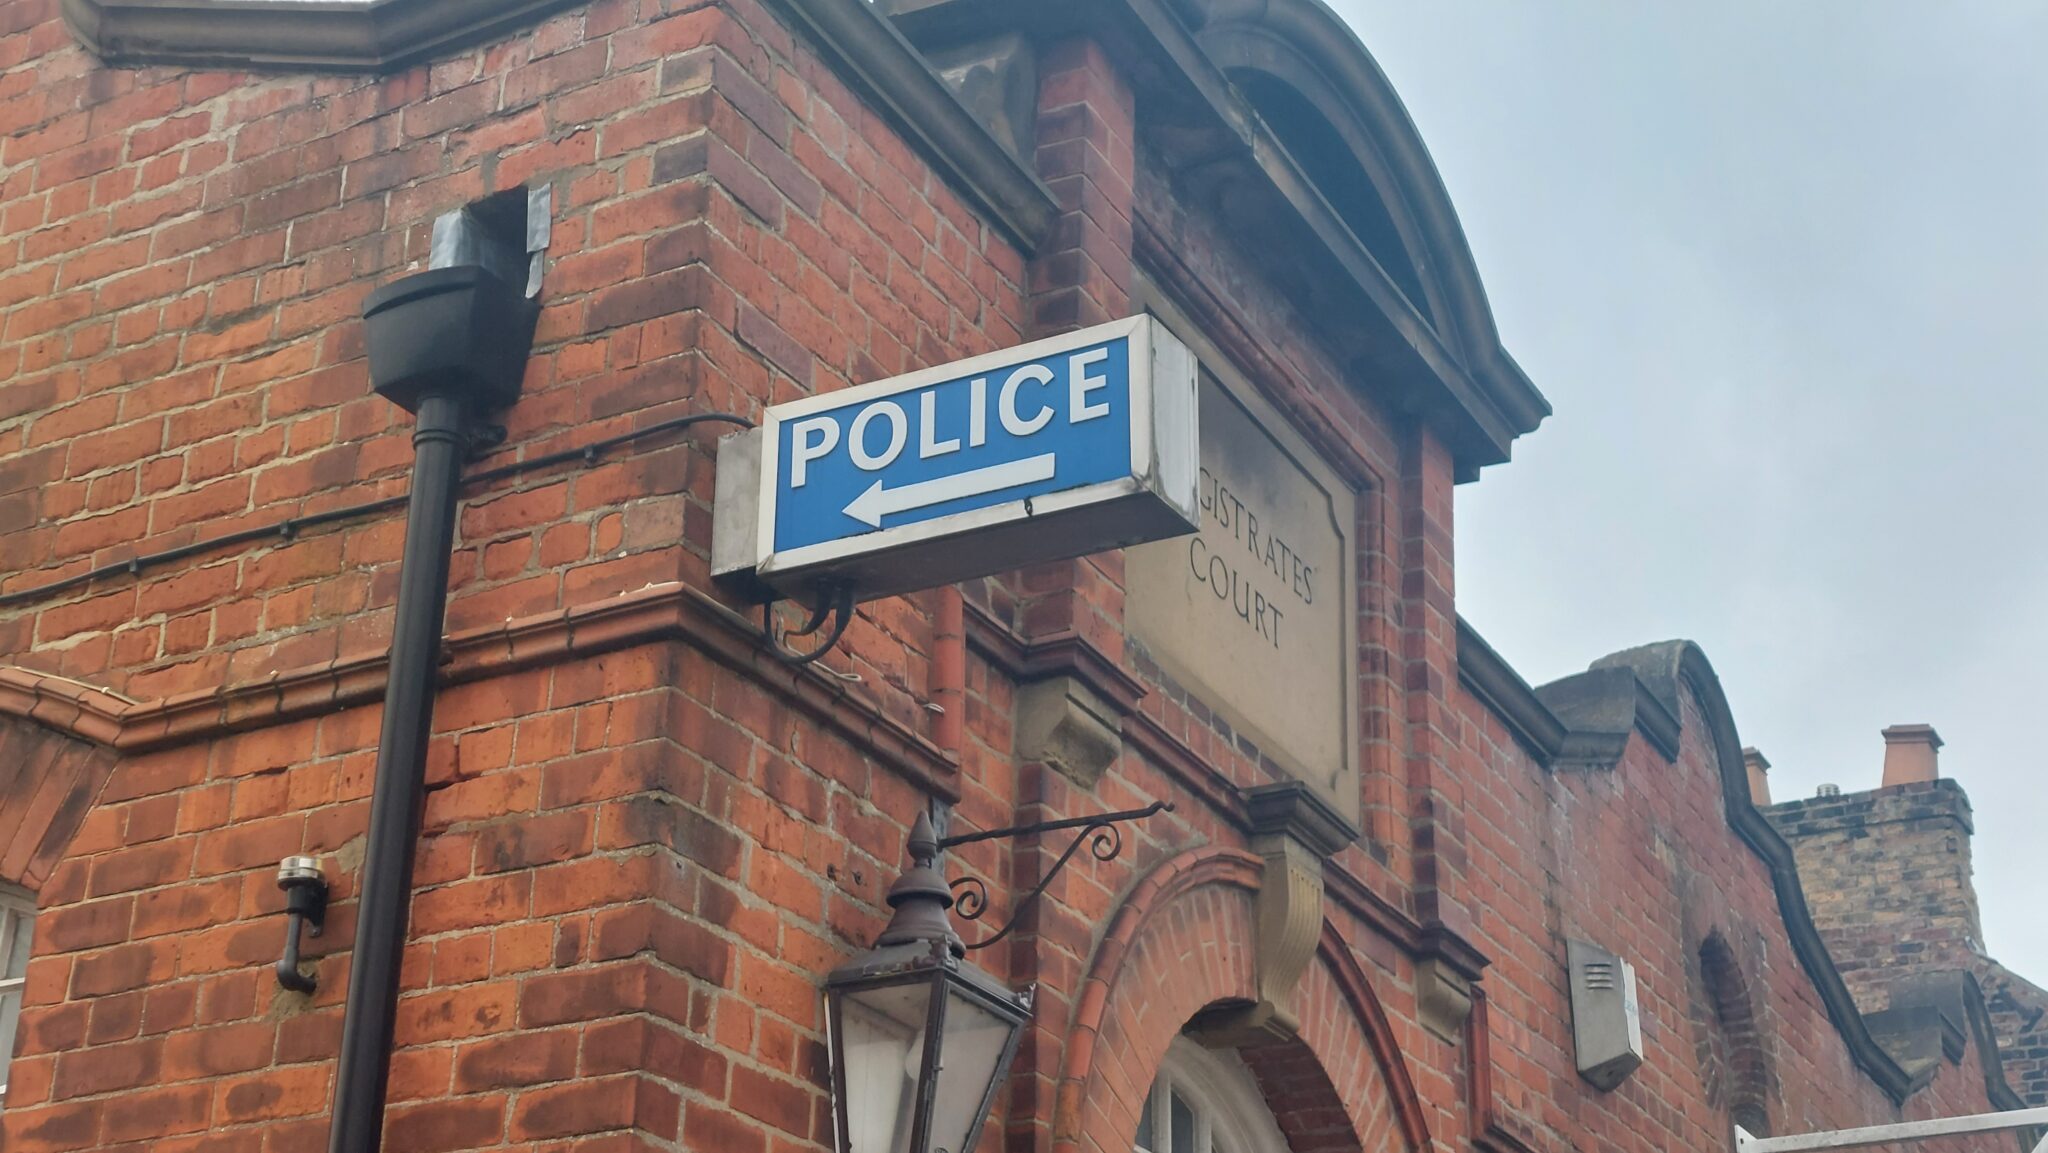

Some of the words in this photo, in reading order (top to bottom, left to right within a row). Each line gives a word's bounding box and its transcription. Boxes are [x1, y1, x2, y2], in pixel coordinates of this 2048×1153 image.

[790, 346, 1110, 488] POLICE
[1190, 536, 1284, 649] COURT
[1199, 466, 1313, 605] GISTRATES
